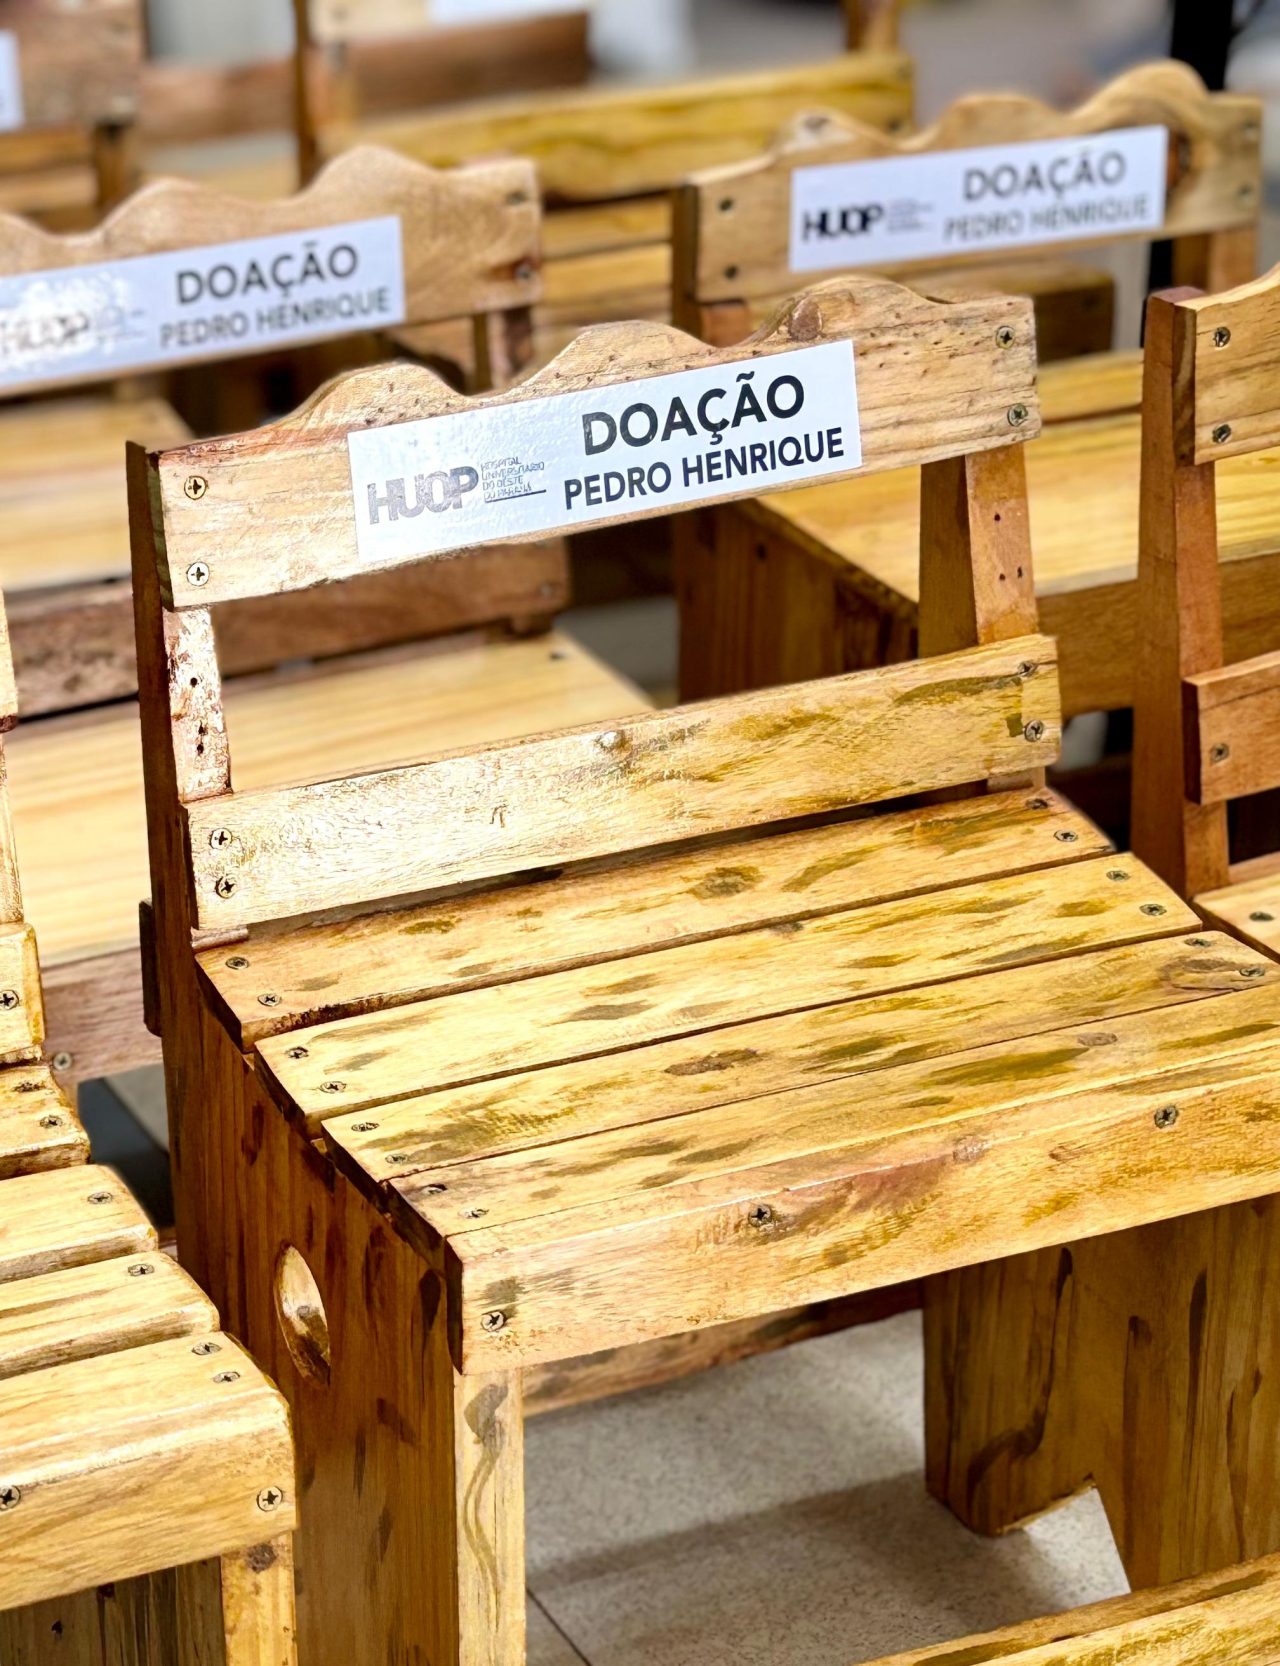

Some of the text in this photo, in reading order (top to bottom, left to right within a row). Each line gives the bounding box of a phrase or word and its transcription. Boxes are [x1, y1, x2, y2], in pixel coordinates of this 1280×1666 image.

[963, 151, 1126, 200] DOAÇÃO
[802, 203, 883, 242] HUOP
[176, 240, 359, 305] DOAÇÃO
[160, 311, 250, 349] PEDRO
[255, 287, 393, 334] HENRIQUE
[582, 370, 806, 456] DOAÇÃO
[367, 466, 479, 525] HUOP
[564, 426, 845, 511] PEDRO HENRIQUE
